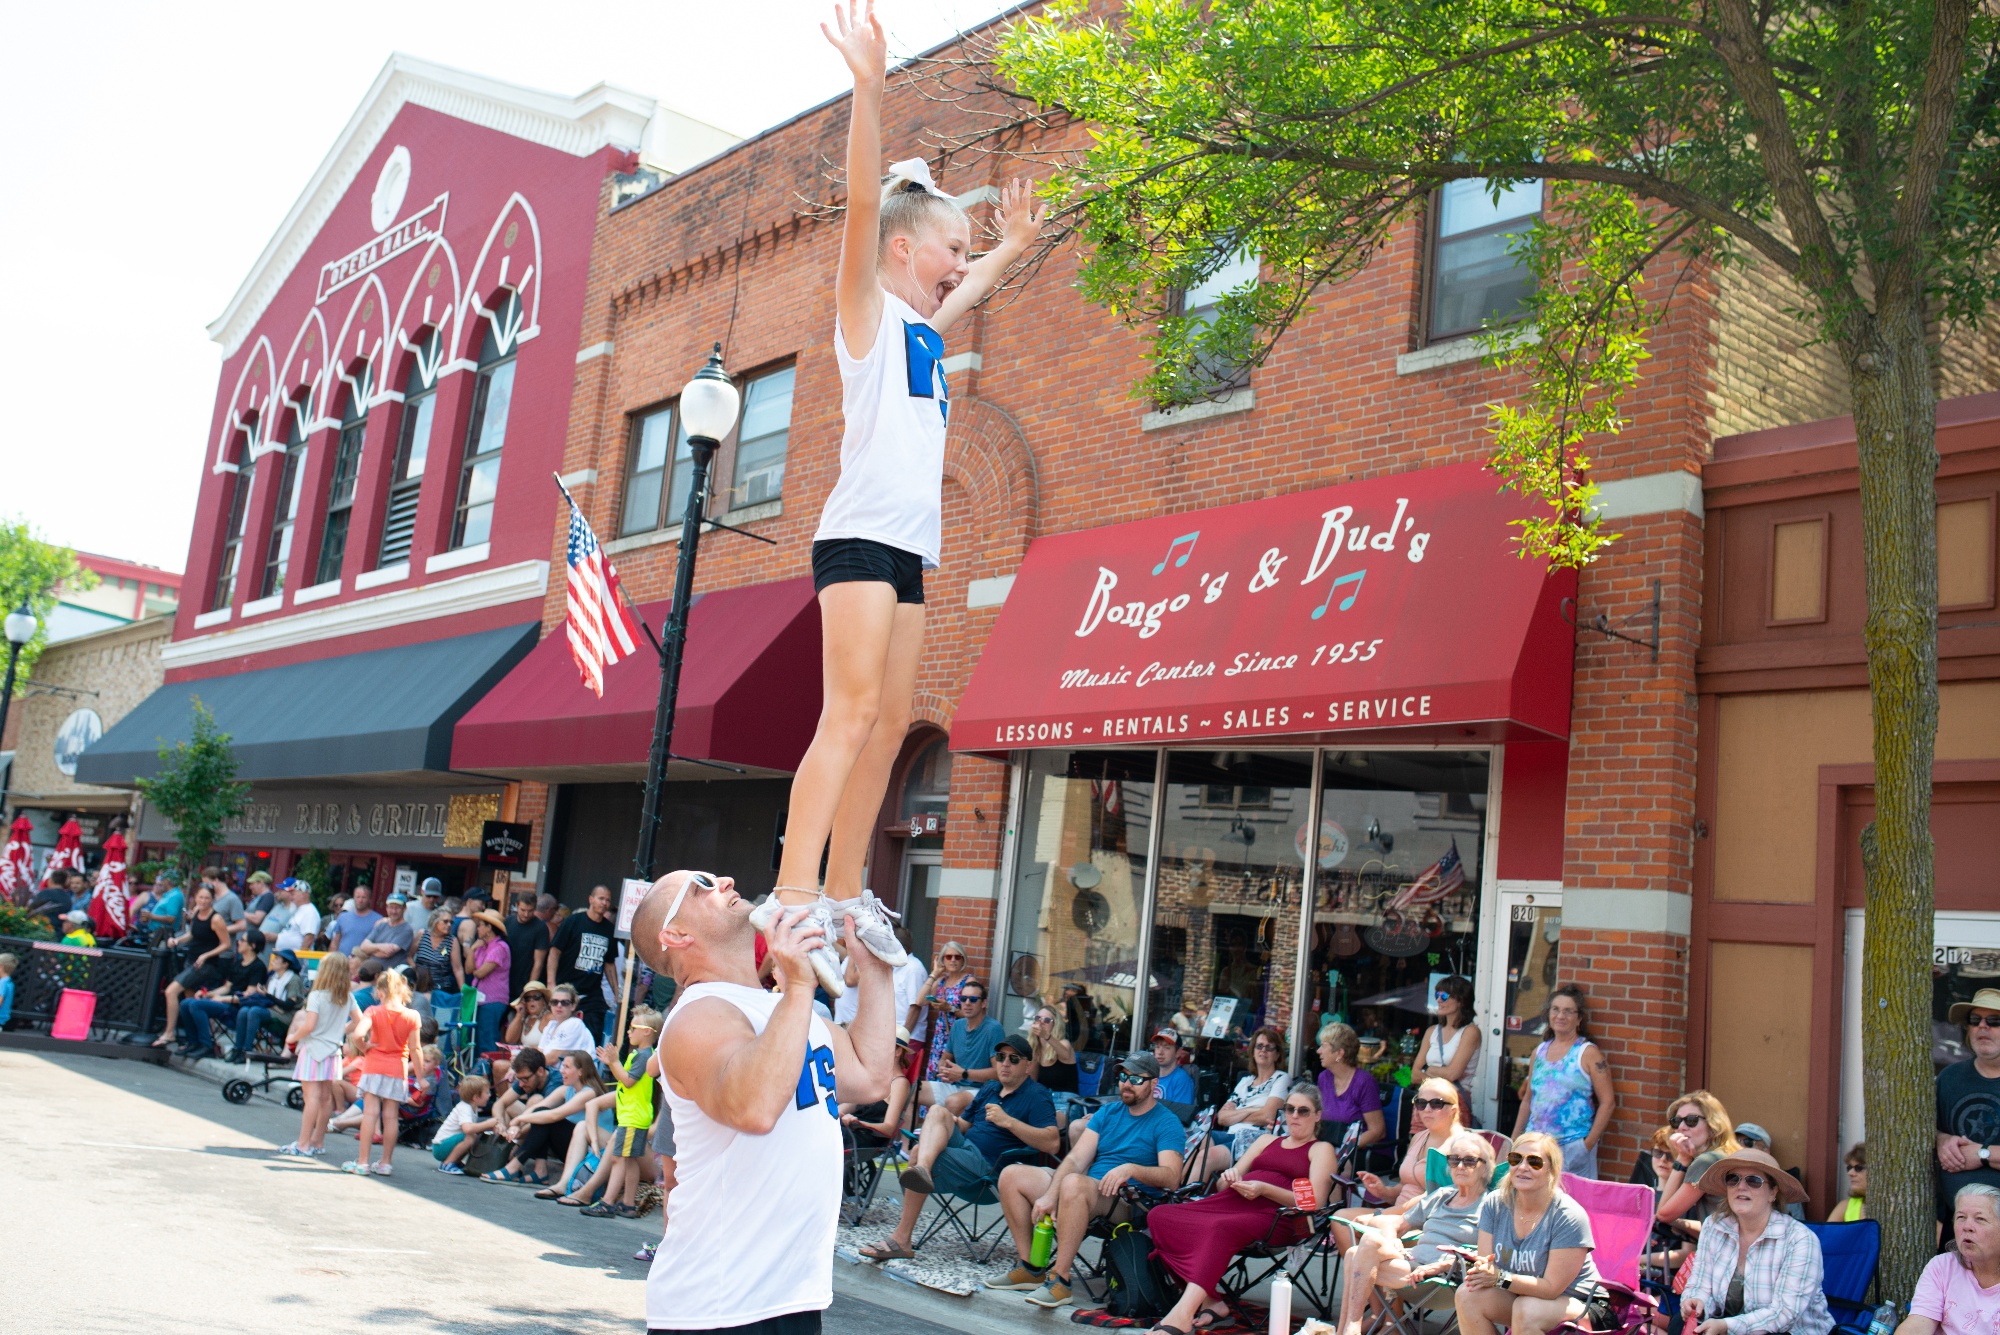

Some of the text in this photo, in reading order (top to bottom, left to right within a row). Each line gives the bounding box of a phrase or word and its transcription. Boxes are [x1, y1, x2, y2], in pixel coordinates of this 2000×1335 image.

[330, 245, 378, 286] OPERA
[1074, 498, 1431, 639] Bongo's & Bud's
[1059, 639, 1384, 689] Music Center Since 1955
[996, 722, 1074, 743] LESSONS
[1102, 714, 1189, 737] RENTALS
[1222, 706, 1290, 730] SALES
[1328, 695, 1431, 722] SERVICE
[293, 803, 340, 836] BAR
[345, 803, 362, 836] &
[367, 803, 448, 838] GRILL
[636, 887, 648, 897] NO
[1513, 906, 1534, 921] 820
